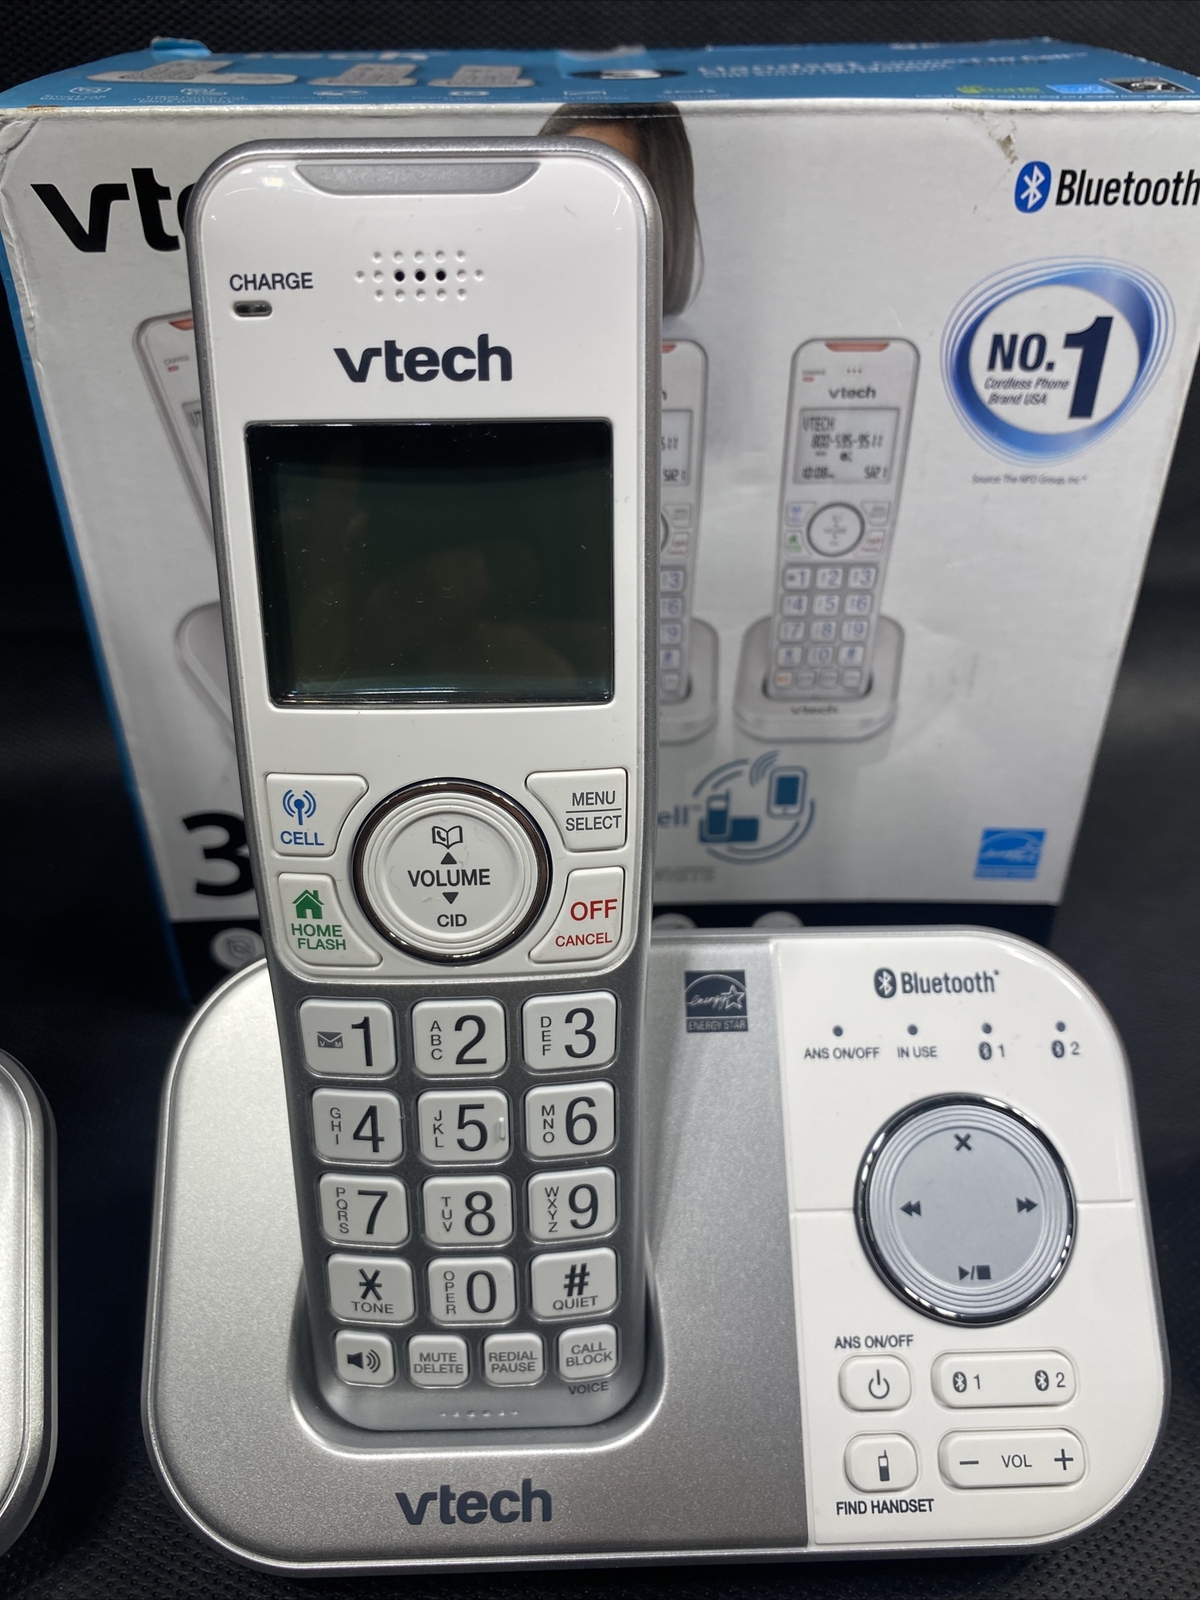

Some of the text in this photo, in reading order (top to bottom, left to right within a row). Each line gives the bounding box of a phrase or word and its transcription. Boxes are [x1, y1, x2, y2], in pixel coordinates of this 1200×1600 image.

[1055, 168, 1200, 206] Bluetooth
[229, 271, 314, 291] CHARGE
[333, 333, 513, 383] vtech
[986, 315, 1114, 420] NO. 1
[984, 376, 1070, 390] Cordless Phone
[828, 384, 877, 400] vtech
[987, 391, 1047, 405] Brand USA
[802, 416, 836, 432] VTECH
[571, 789, 617, 807] MENU
[565, 815, 623, 832] SELECT
[280, 830, 325, 847] CELL
[407, 868, 491, 887] VOLUME
[569, 898, 619, 922] OFF
[436, 913, 468, 928] CID
[291, 923, 344, 939] HOME
[297, 937, 347, 951] FLASH
[554, 931, 613, 949] CANCEL
[563, 1007, 597, 1059] 3
[688, 1019, 747, 1032] ENERGY STAR
[350, 1015, 375, 1067] 1
[453, 1014, 489, 1065] 2
[1070, 1041, 1081, 1055] 2
[803, 1046, 880, 1060] ANS ON/OFF
[897, 1045, 938, 1059] IN USE
[998, 1045, 1006, 1058] 1
[352, 1104, 386, 1154] 4
[456, 1103, 489, 1152] 5
[564, 1096, 599, 1146] 6
[357, 1189, 389, 1236] 7
[463, 1190, 497, 1237] 8
[567, 1183, 600, 1230] 9
[466, 1269, 497, 1314] 0
[351, 1300, 395, 1315] TONE
[552, 1295, 599, 1312] QUIET
[570, 1341, 608, 1356] CALL
[834, 1334, 915, 1350] ANS ON/OFF
[418, 1351, 458, 1363] MUTE
[488, 1350, 538, 1363] REDIAL
[565, 1351, 614, 1368] BLOCK
[413, 1362, 465, 1375] DELETE
[491, 1361, 537, 1374] PAUSE
[567, 1380, 610, 1396] VOICE
[972, 1374, 981, 1390] 1
[1055, 1372, 1067, 1388] 2
[1001, 1453, 1033, 1468] VOL
[394, 1478, 553, 1526] vtech
[835, 1497, 935, 1516] FIND HANDSET
